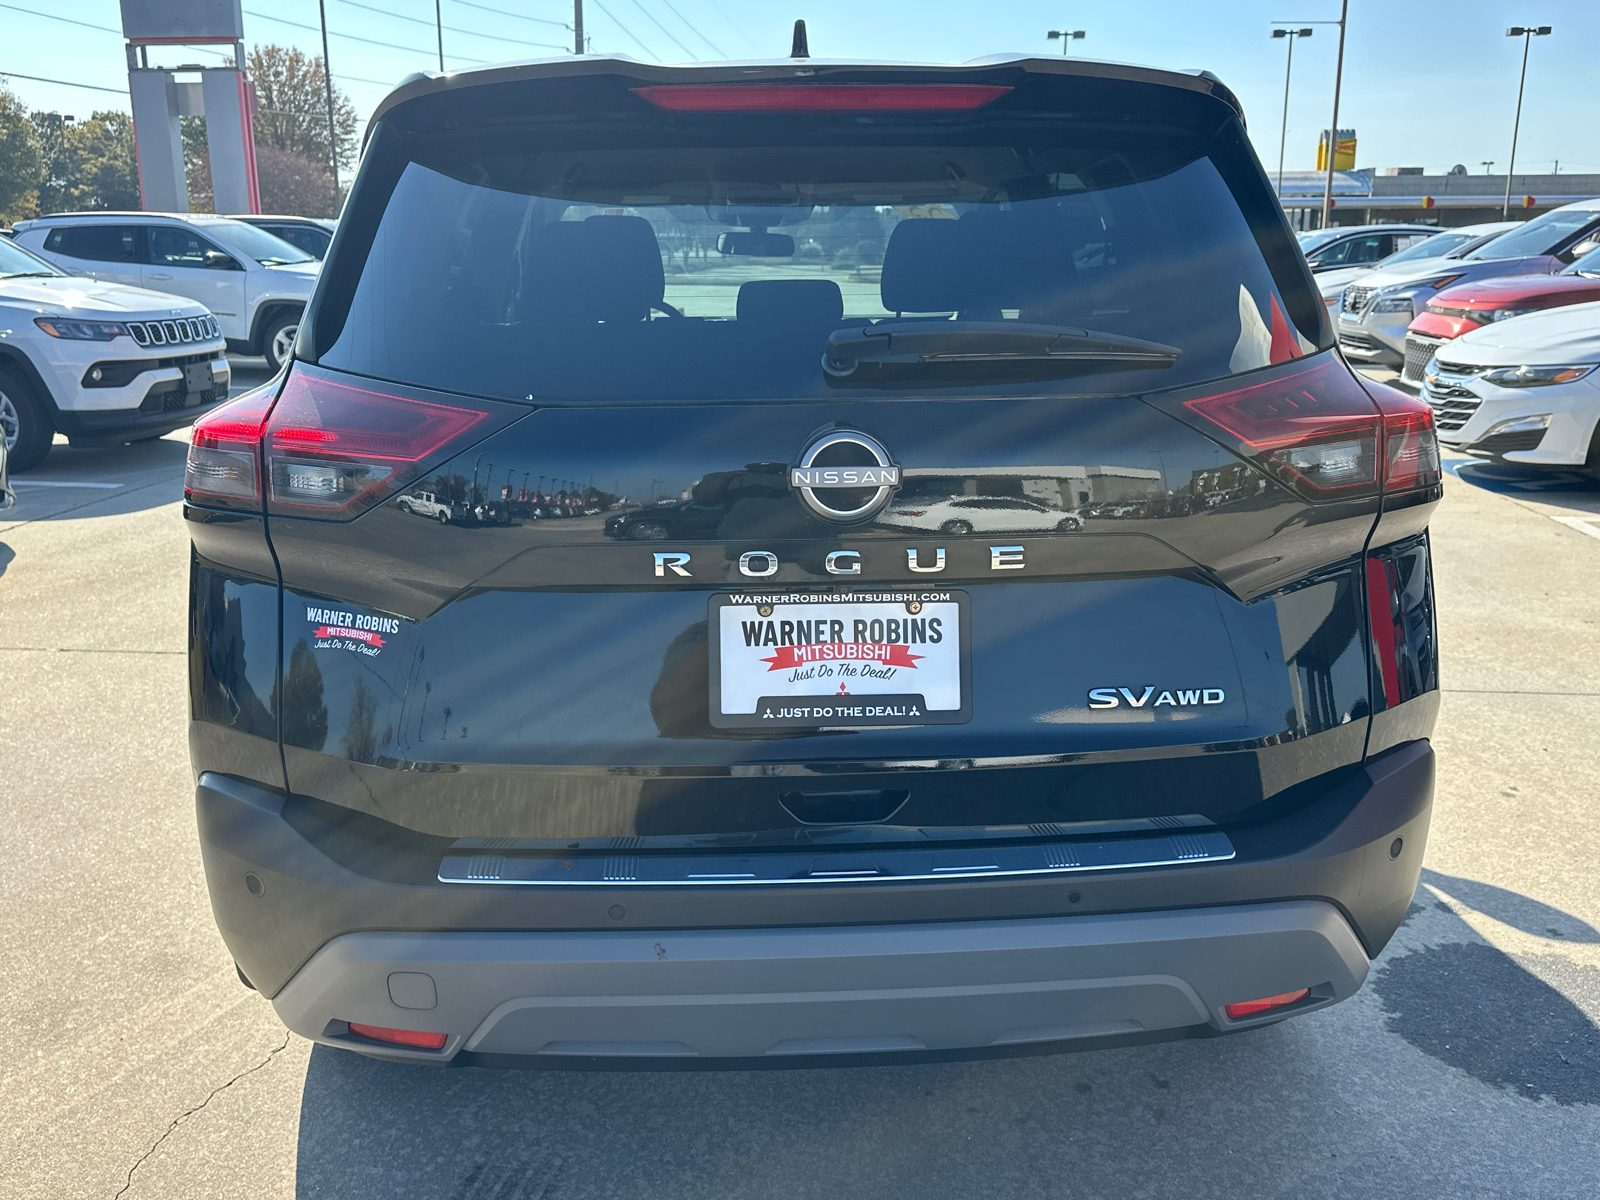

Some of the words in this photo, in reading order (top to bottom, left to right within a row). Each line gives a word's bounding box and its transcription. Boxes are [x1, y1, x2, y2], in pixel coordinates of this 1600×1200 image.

[795, 470, 897, 484] NISSAN
[652, 545, 1027, 577] ROGUE
[306, 607, 353, 627] WARNER
[355, 614, 400, 634] ROBINS
[327, 627, 373, 641] MITSUBISHI
[741, 619, 844, 647] WARNER
[853, 617, 943, 644] ROBINS
[314, 639, 332, 649] Just
[332, 639, 342, 649] Do
[343, 640, 356, 651] The
[357, 643, 381, 657] Deal!
[793, 645, 891, 662] MITSUBISHI
[788, 666, 815, 683] Just
[818, 664, 833, 678] Do
[838, 663, 857, 677] The
[860, 666, 897, 681] Deal!
[1088, 686, 1155, 709] SV
[1153, 688, 1225, 707] AWD
[776, 708, 810, 718] JUST
[813, 707, 833, 718] DO
[835, 707, 863, 717] THE
[865, 706, 906, 716] DEAL!
